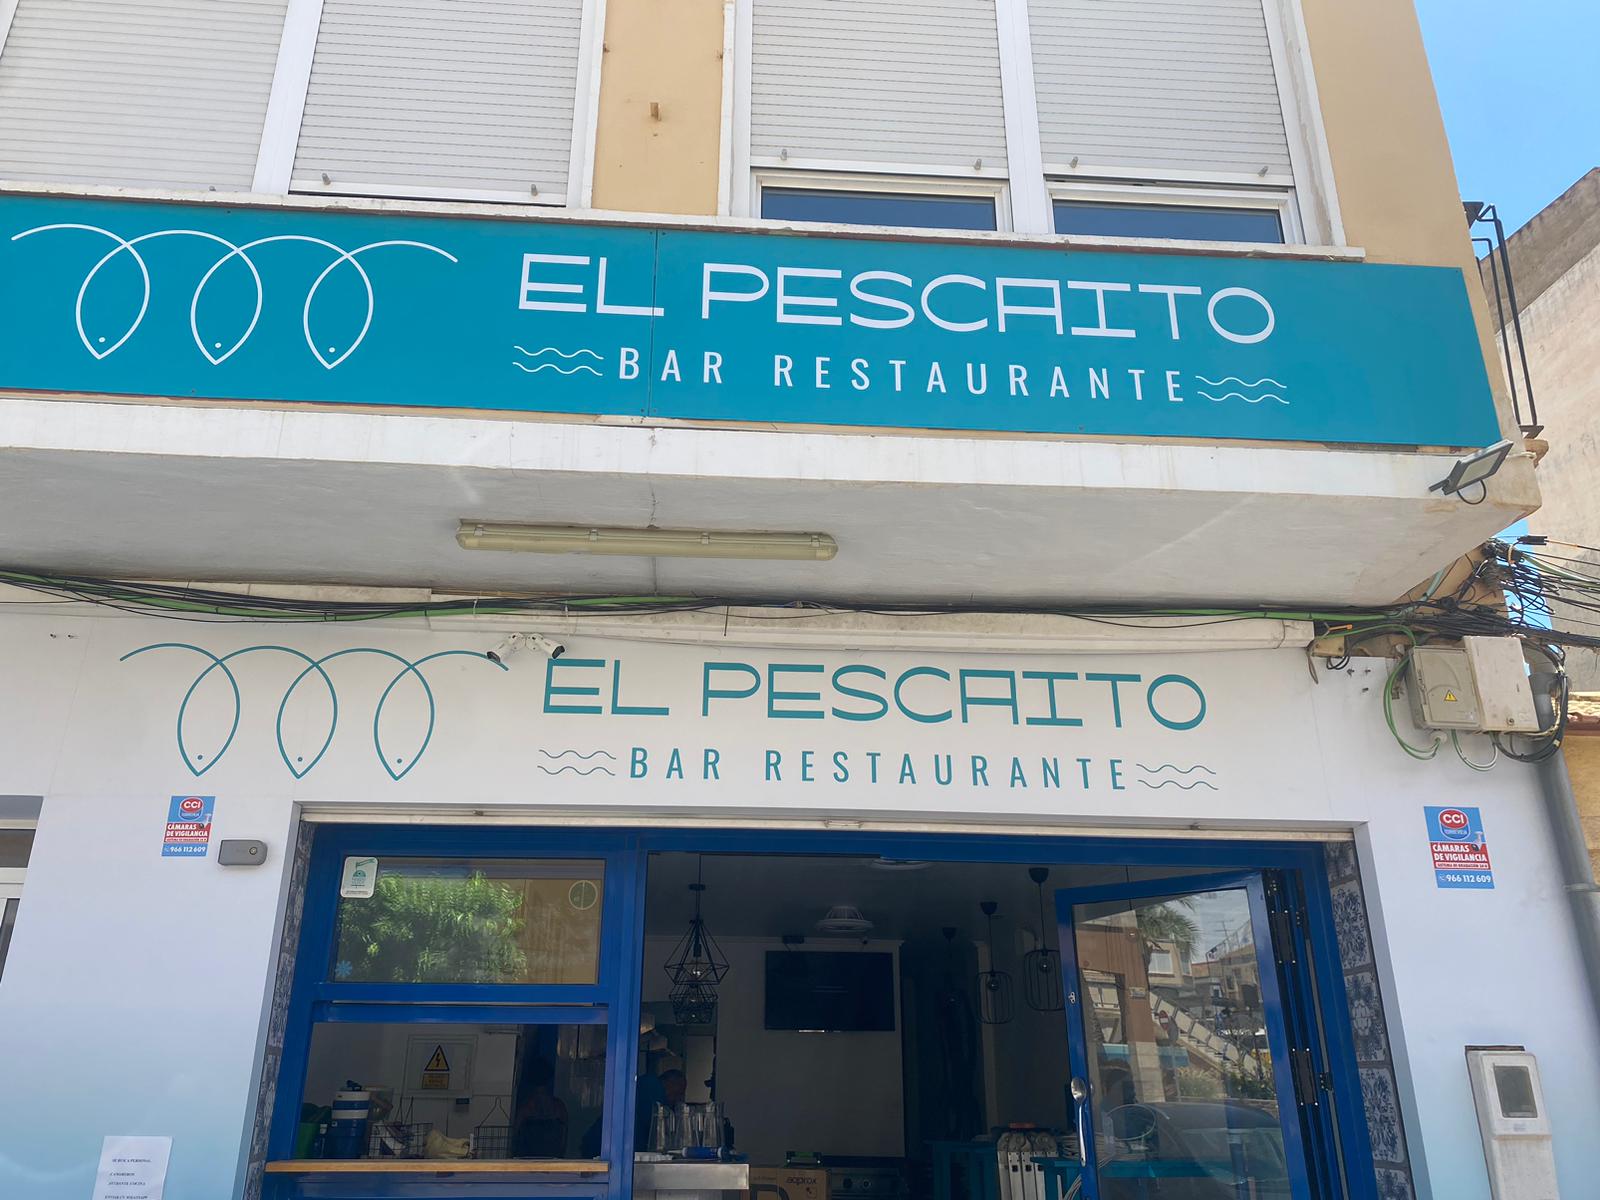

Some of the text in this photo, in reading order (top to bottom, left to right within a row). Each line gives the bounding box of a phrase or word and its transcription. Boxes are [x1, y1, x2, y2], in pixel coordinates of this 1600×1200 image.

[518, 252, 1275, 344] EL PESCAITO
[619, 347, 1184, 402] BAR RESTAURANTE
[543, 658, 1207, 731] EL PESCAITO
[629, 747, 1126, 790] BAR RESTAURANTE
[183, 801, 201, 809] CCI
[1442, 813, 1465, 824] CCI
[1432, 843, 1470, 853] CÁMARAS
[1433, 853, 1488, 862] DE VIGILANCIA
[1446, 874, 1491, 883] 966 112 609
